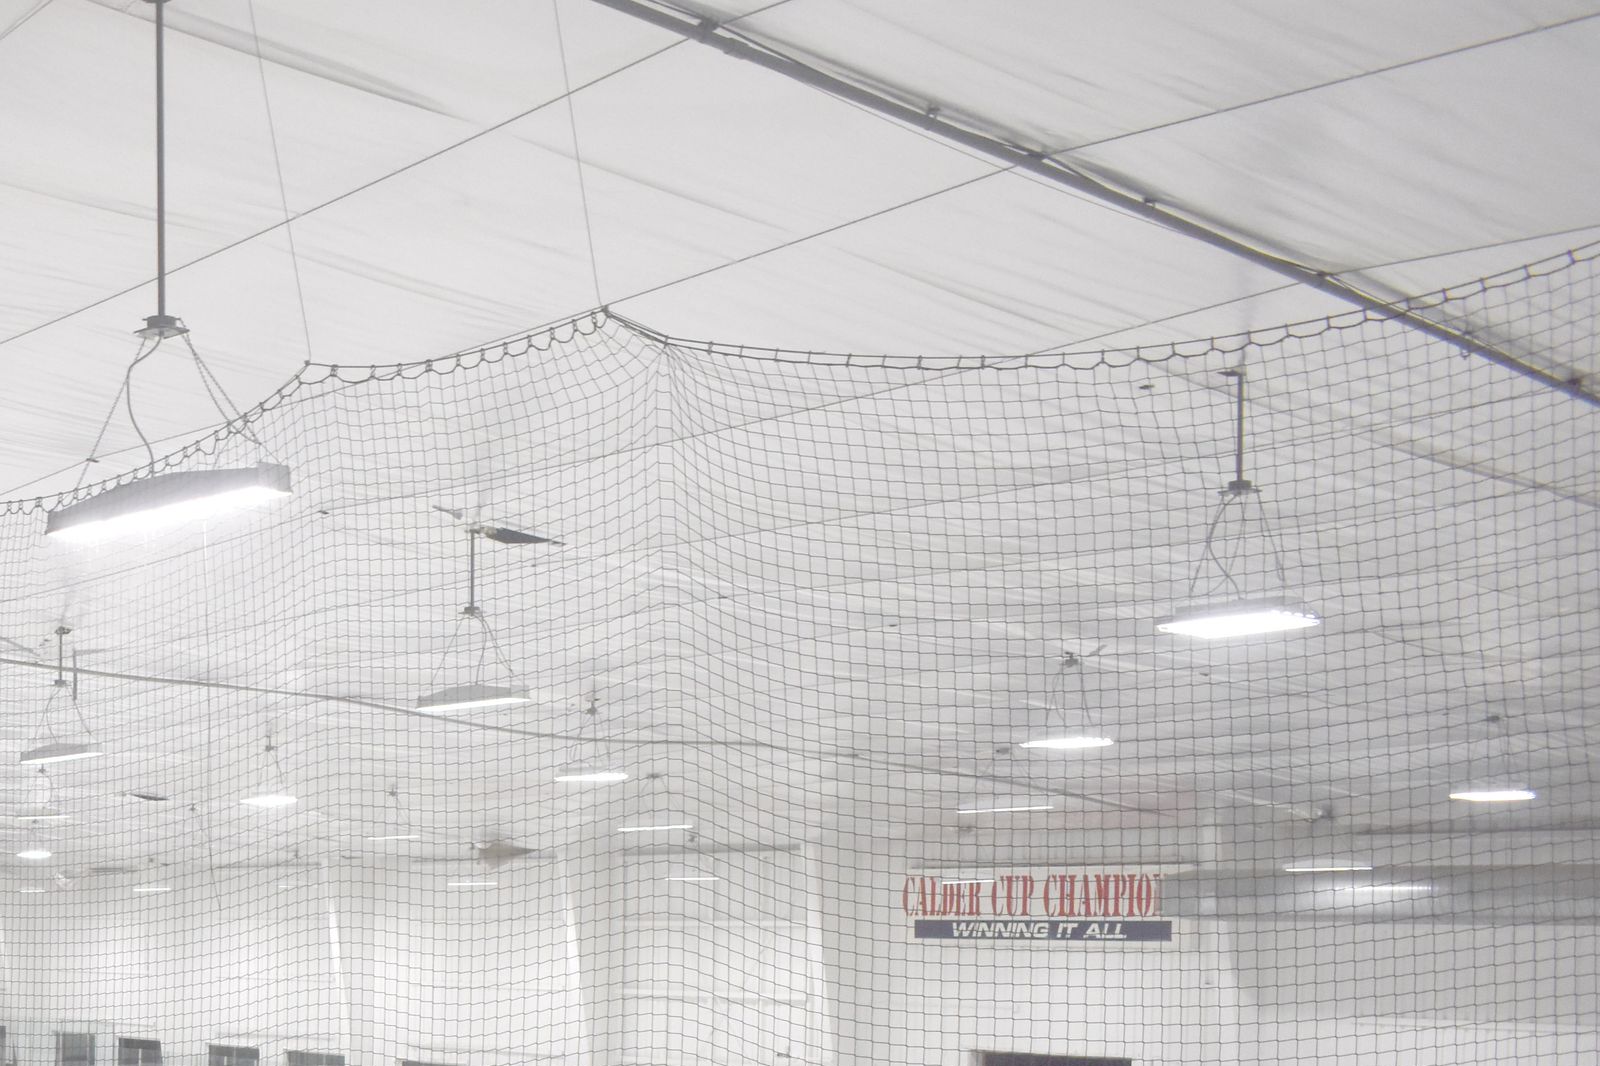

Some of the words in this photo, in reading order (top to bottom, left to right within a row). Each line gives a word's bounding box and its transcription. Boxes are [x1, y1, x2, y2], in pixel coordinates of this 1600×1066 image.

[903, 875, 982, 916] CALDER
[991, 875, 1035, 917] CUP
[952, 921, 1050, 939] WINNING
[1056, 922, 1079, 939] IT
[1082, 922, 1128, 939] ALL
